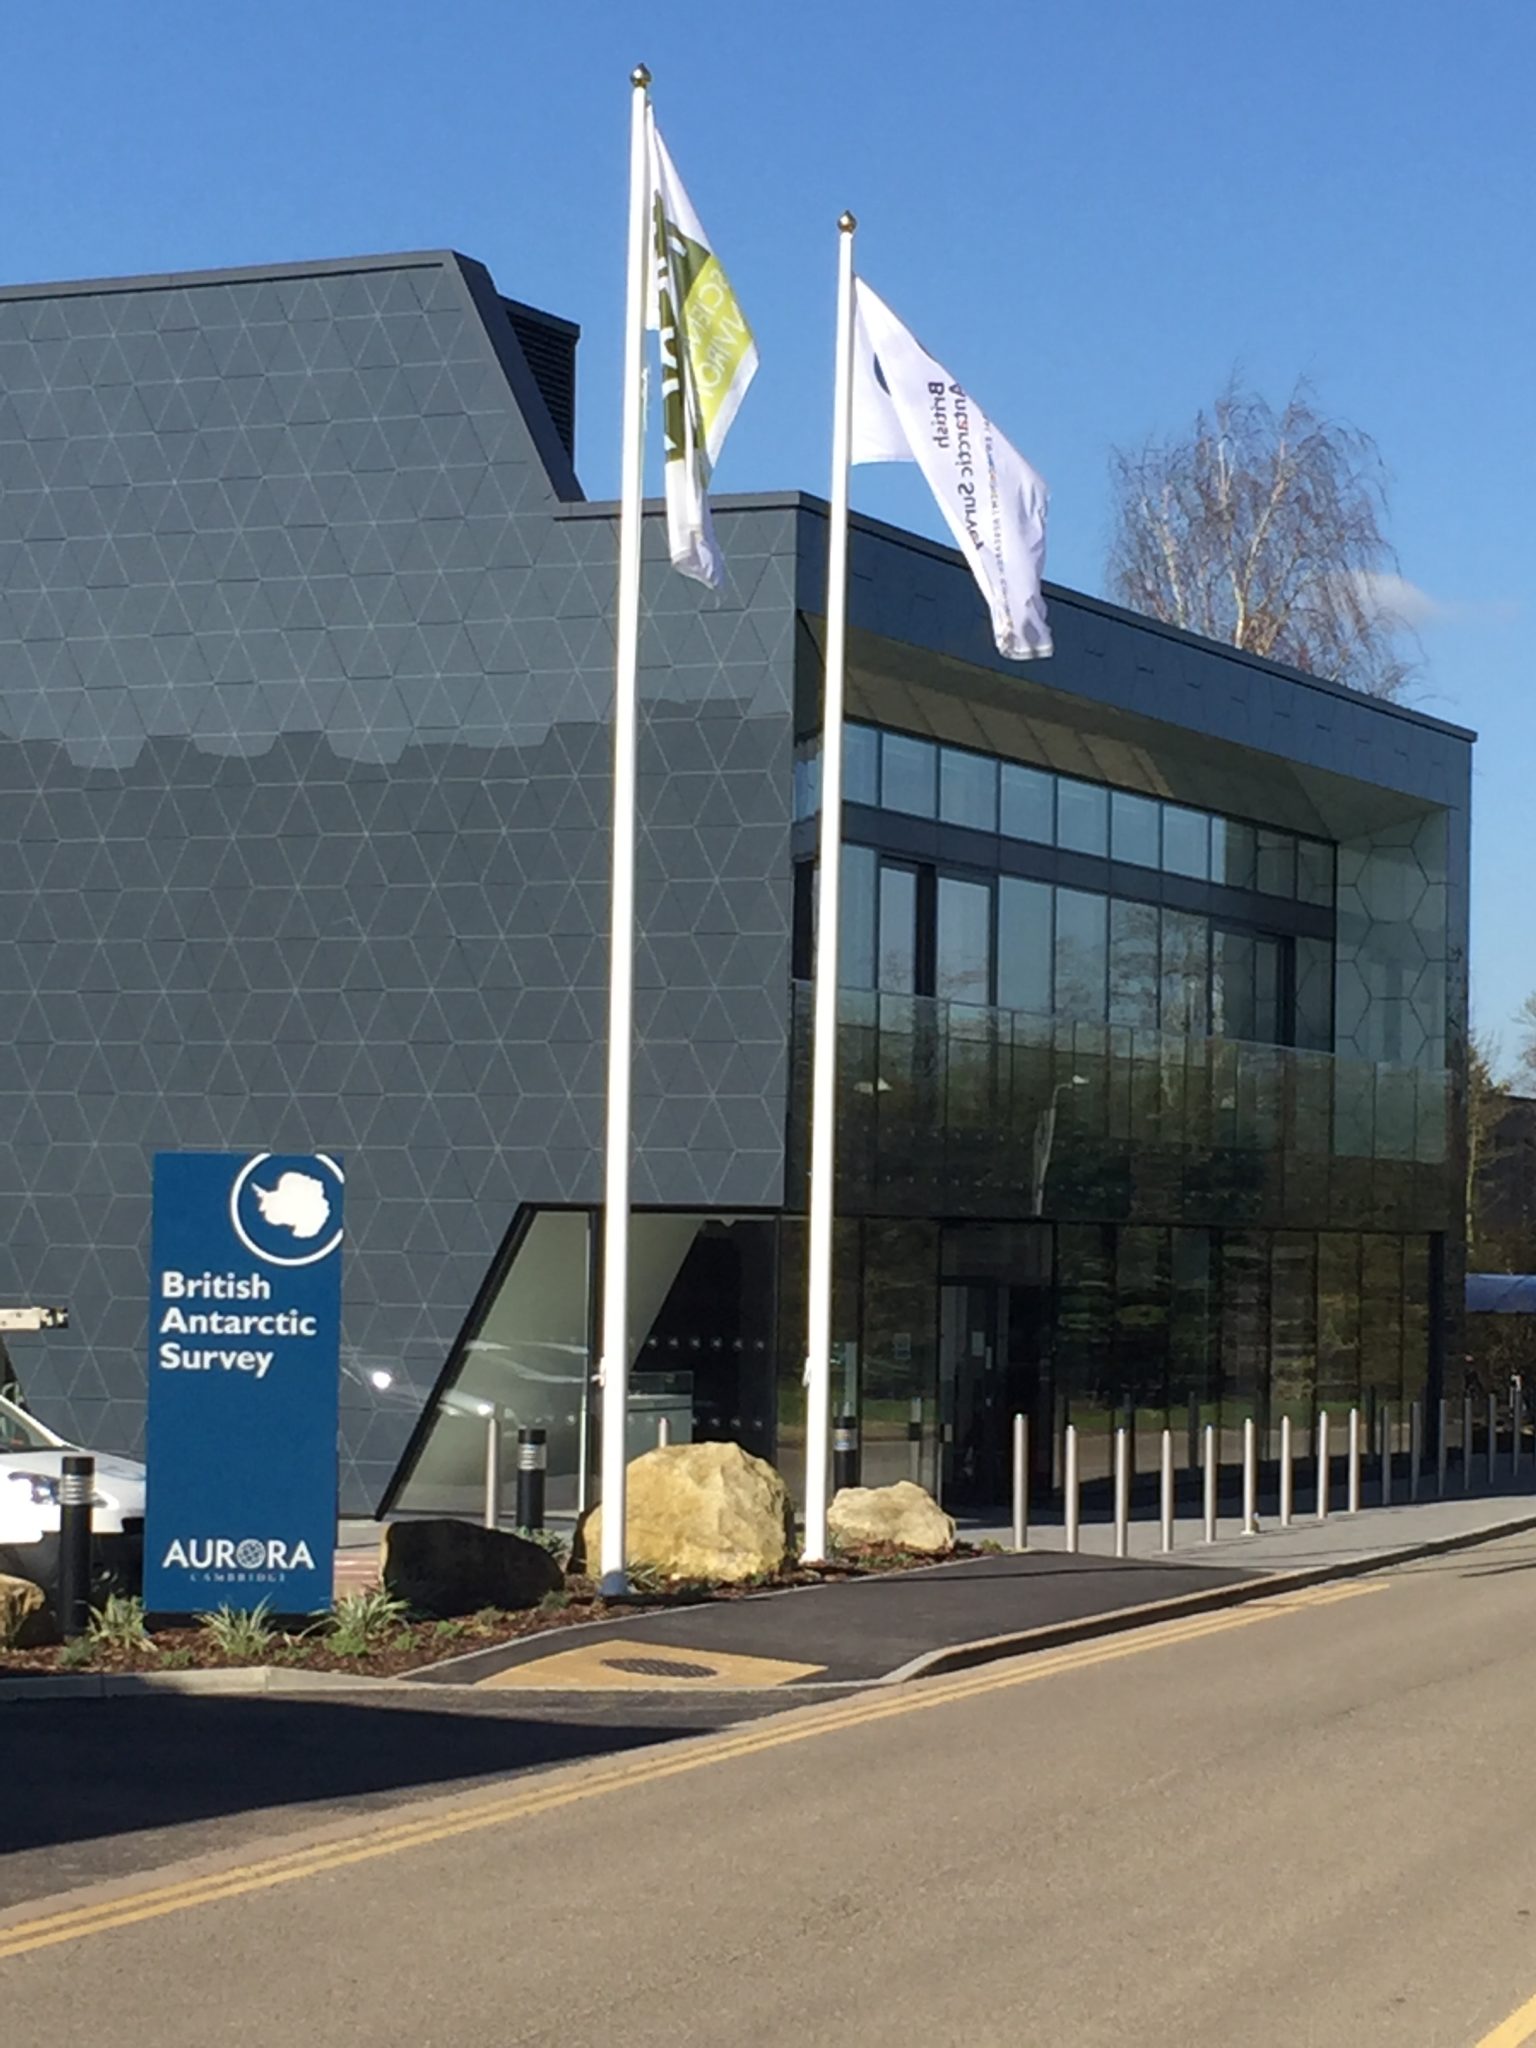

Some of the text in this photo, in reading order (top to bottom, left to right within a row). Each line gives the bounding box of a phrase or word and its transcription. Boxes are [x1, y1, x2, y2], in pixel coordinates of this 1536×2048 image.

[163, 1271, 270, 1299] British
[160, 1307, 316, 1335] Antarctic
[160, 1343, 273, 1378] Survey
[163, 1539, 314, 1569] AURORA
